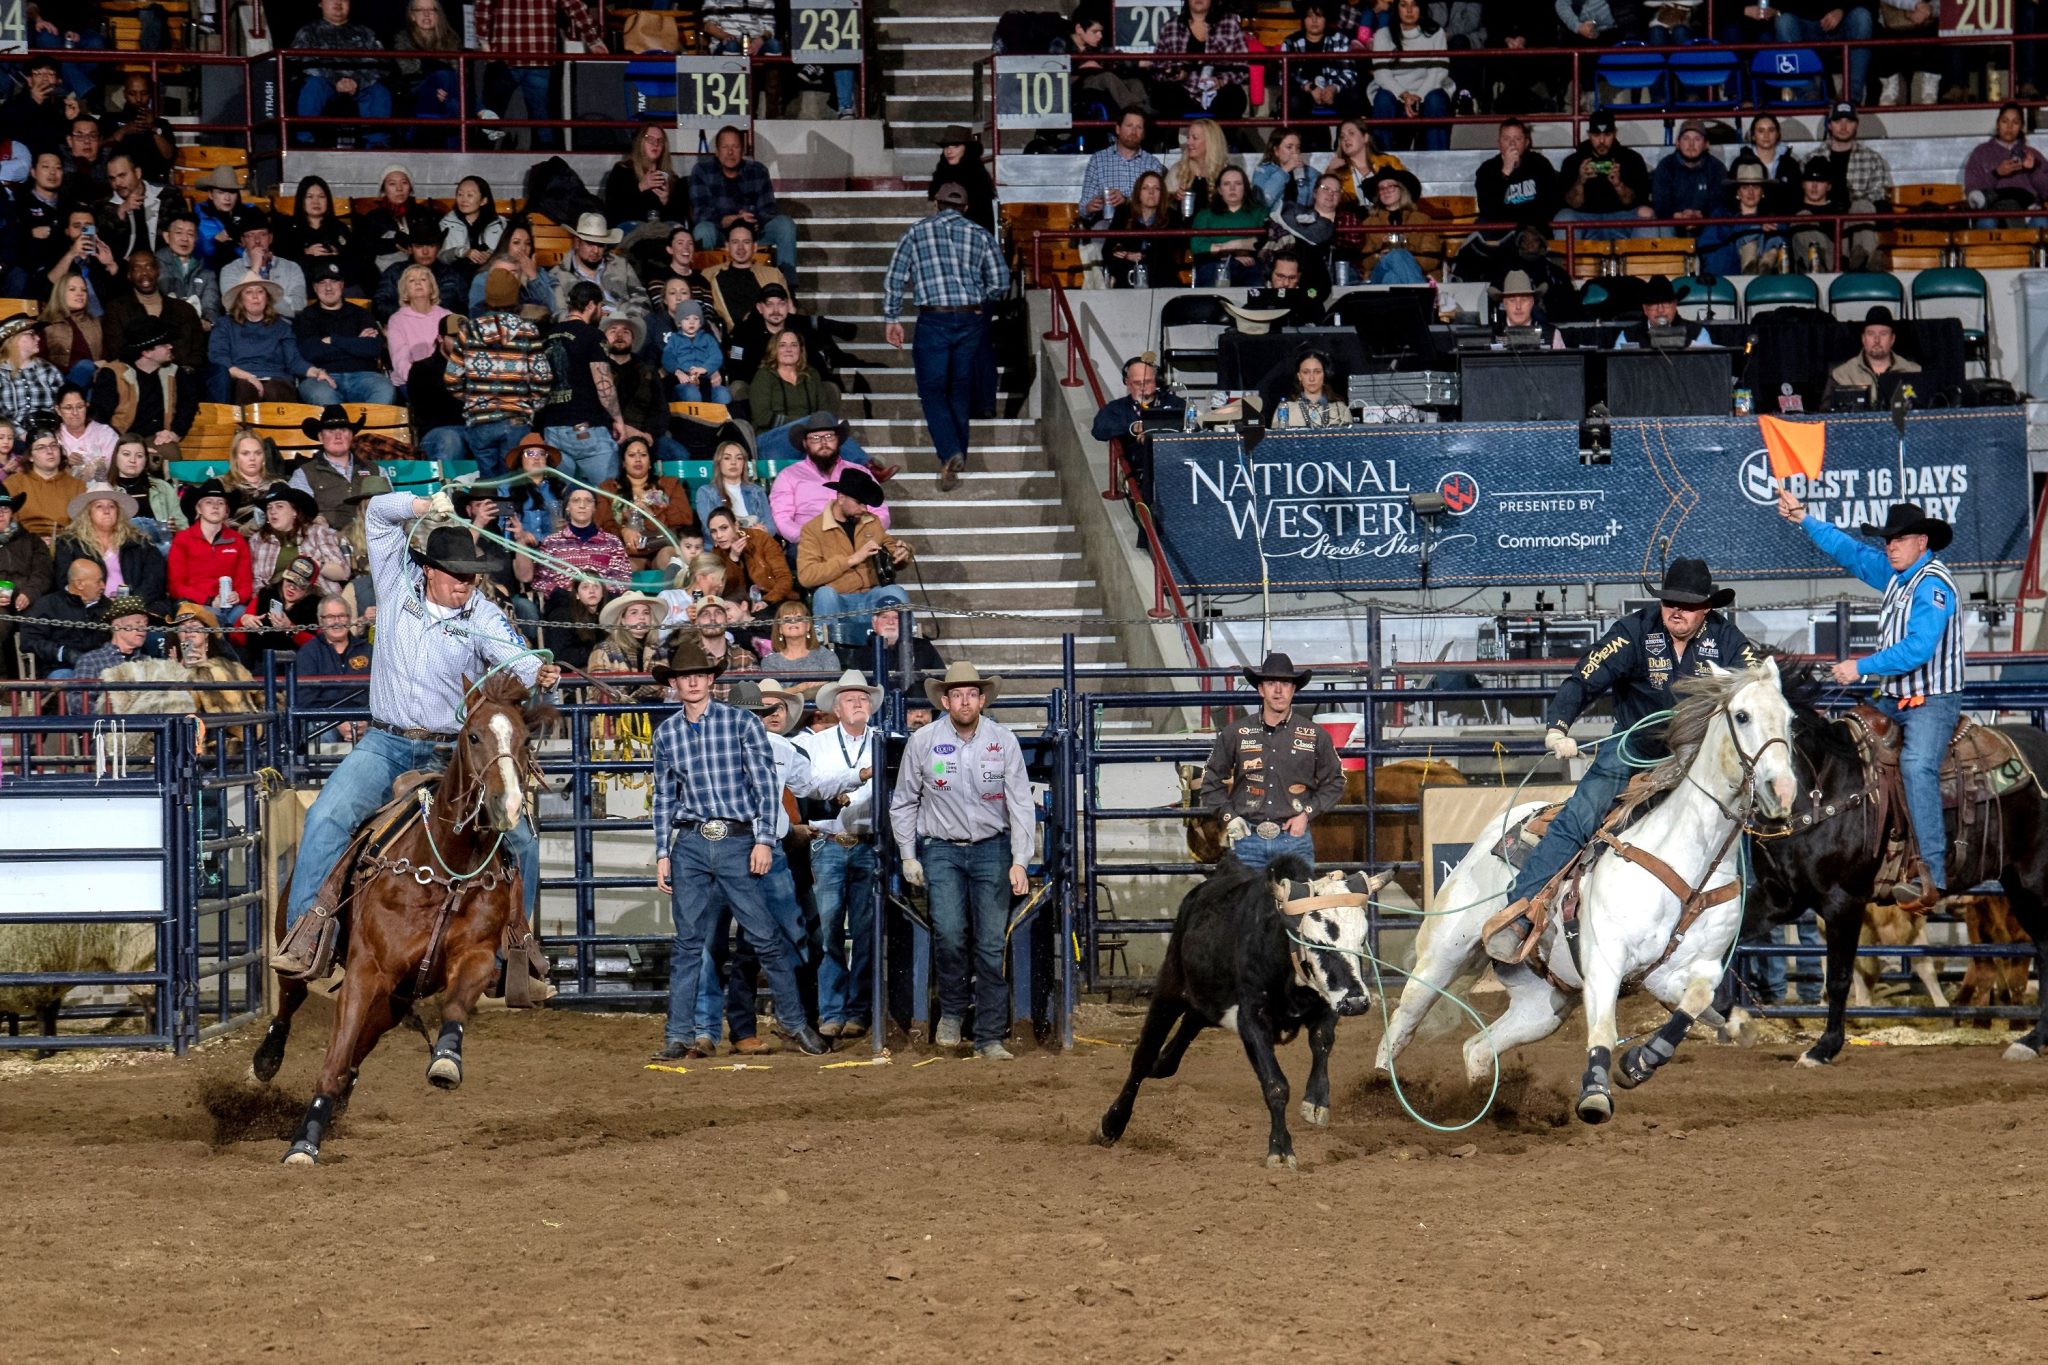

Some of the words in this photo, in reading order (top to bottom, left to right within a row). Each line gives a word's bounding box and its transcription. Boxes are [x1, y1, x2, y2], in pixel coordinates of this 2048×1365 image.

[800, 9, 860, 50] 234
[1130, 6, 1181, 47] 20
[1956, 0, 2011, 31] 201
[265, 81, 274, 113] TRASH
[691, 73, 748, 116] 134
[1016, 72, 1069, 114] 101
[206, 466, 214, 478] 4
[388, 466, 397, 478] 6
[699, 466, 708, 478] 9
[1184, 459, 1411, 505] NATIONAL
[1790, 469, 1860, 498] BEST
[1867, 468, 1893, 498] 16
[1901, 464, 1968, 495] DAYS
[1223, 499, 1436, 540] WESTER
[1500, 500, 1576, 513] PRESENTED
[1580, 499, 1596, 511] BY
[1834, 497, 1961, 529] JANRY
[1300, 533, 1367, 559] Stock
[1498, 532, 1612, 550] CommonSpirit
[1581, 636, 1631, 680] Wrangler
